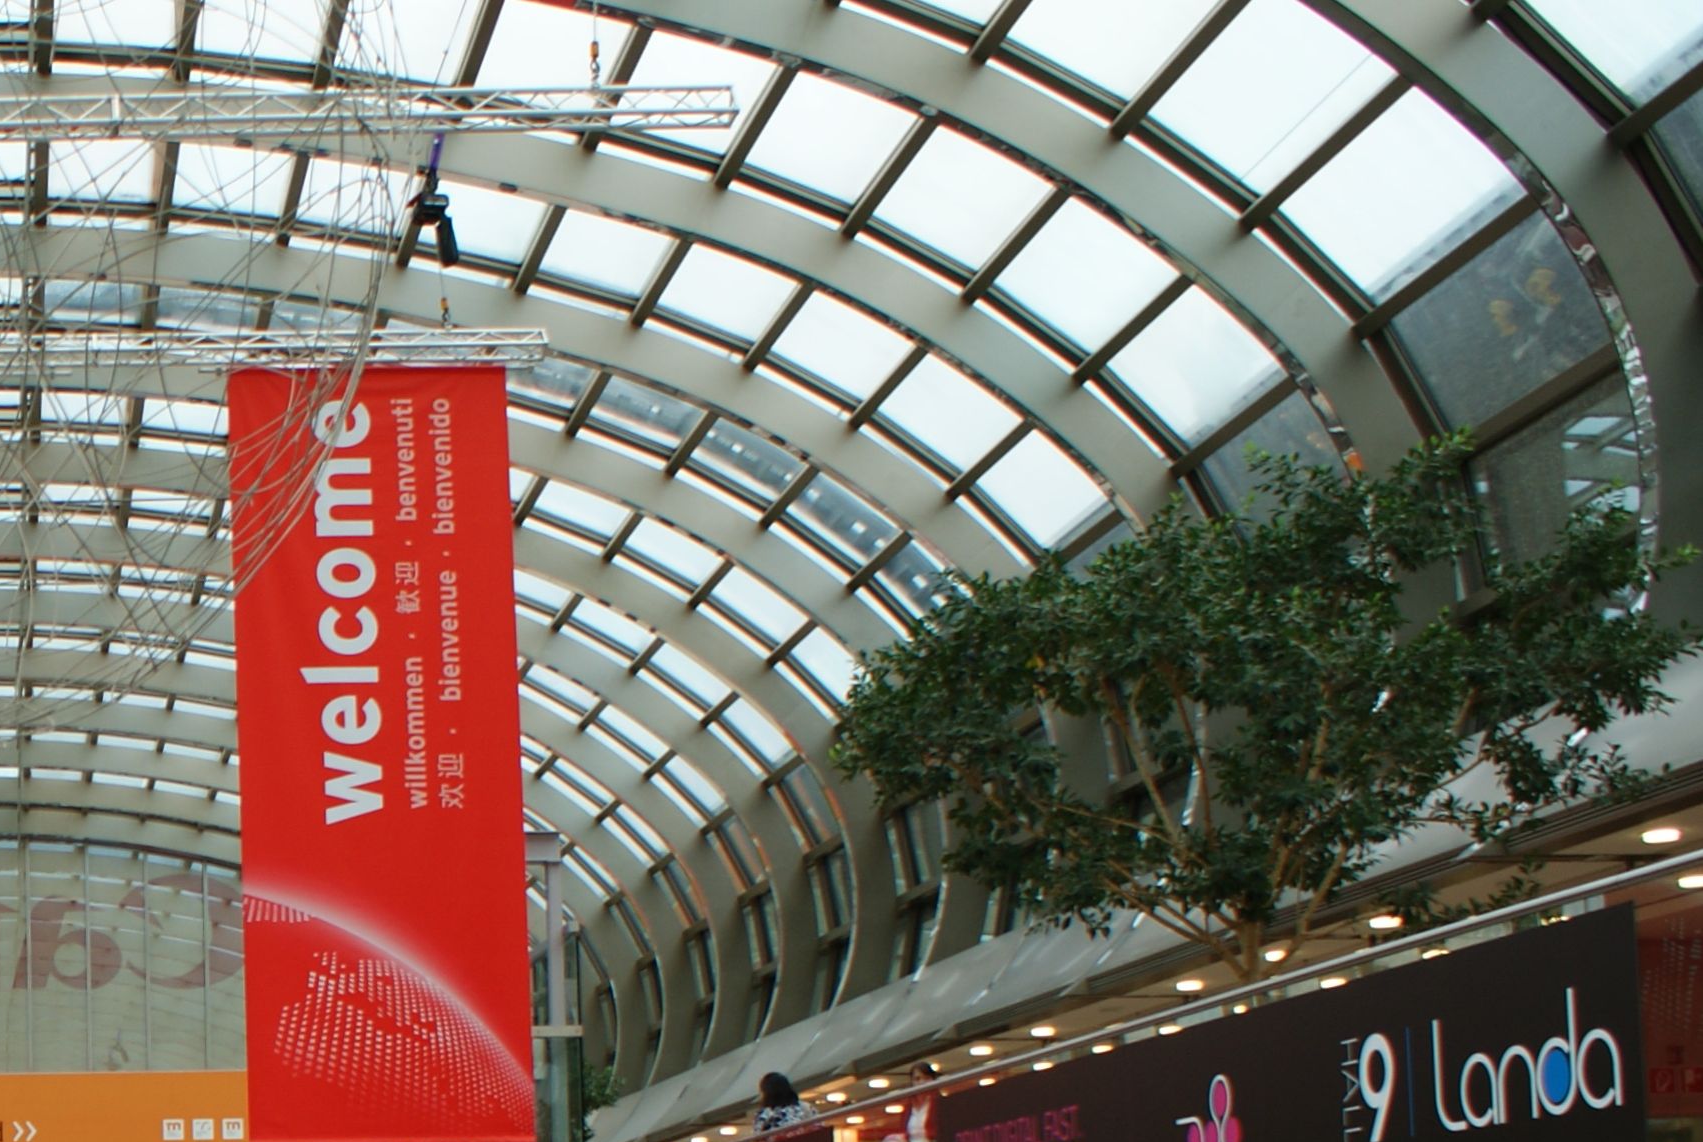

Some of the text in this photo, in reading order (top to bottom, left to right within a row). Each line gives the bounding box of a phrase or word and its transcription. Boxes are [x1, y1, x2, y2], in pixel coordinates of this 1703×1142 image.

[390, 397, 418, 522] benvenuti
[429, 398, 455, 535] bienvenido
[300, 399, 384, 825] welcome
[437, 571, 462, 702] bienvenue
[403, 656, 429, 809] willkommen
[1359, 1033, 1395, 1142] 9
[1431, 987, 1623, 1131] Landa
